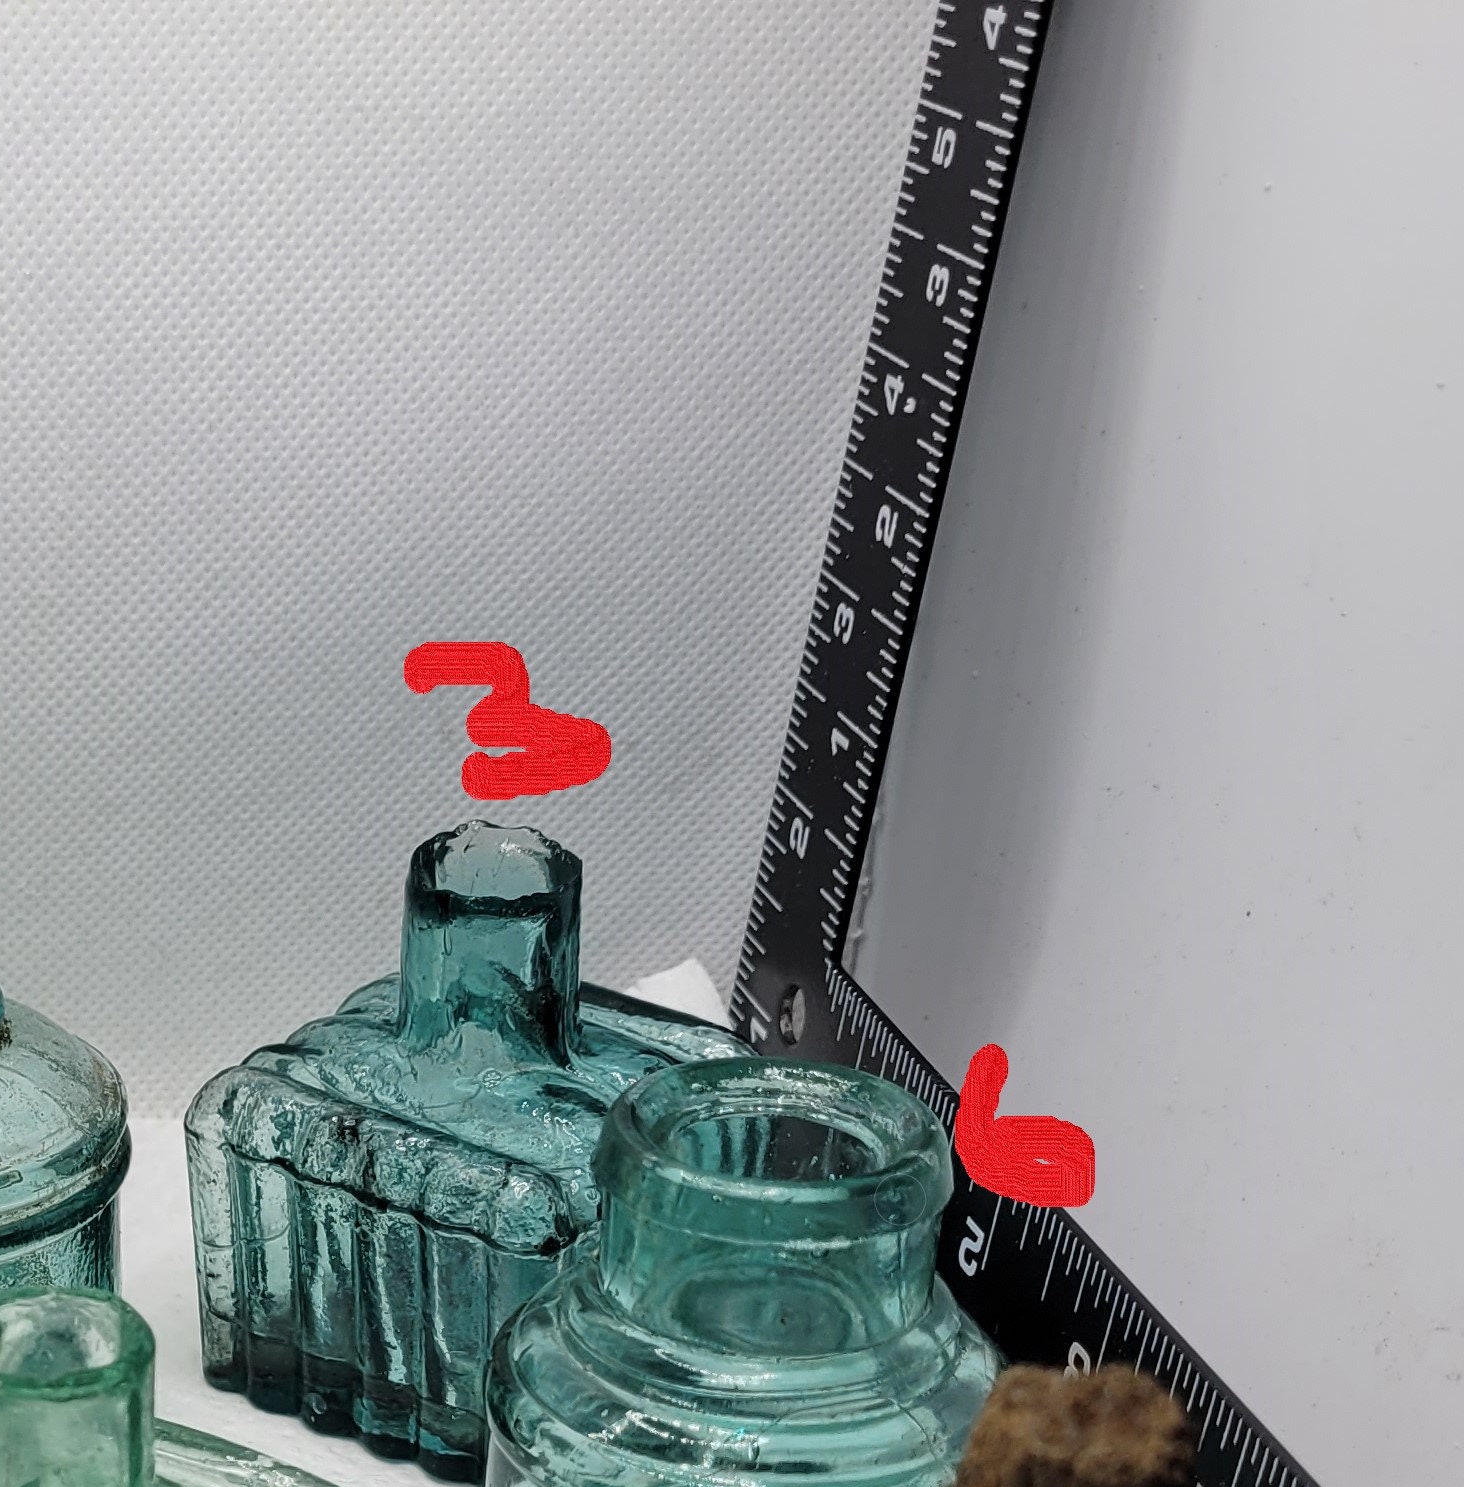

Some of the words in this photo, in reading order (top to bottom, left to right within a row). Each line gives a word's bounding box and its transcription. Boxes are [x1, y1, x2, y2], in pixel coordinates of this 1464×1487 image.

[982, 4, 1008, 51] 4
[931, 126, 957, 169] 5
[925, 263, 950, 307] 3
[883, 374, 905, 416] 4
[875, 504, 899, 549] 2
[833, 602, 856, 645] 3
[830, 727, 851, 756] 1
[789, 816, 812, 860] 2
[958, 1215, 985, 1277] 2
